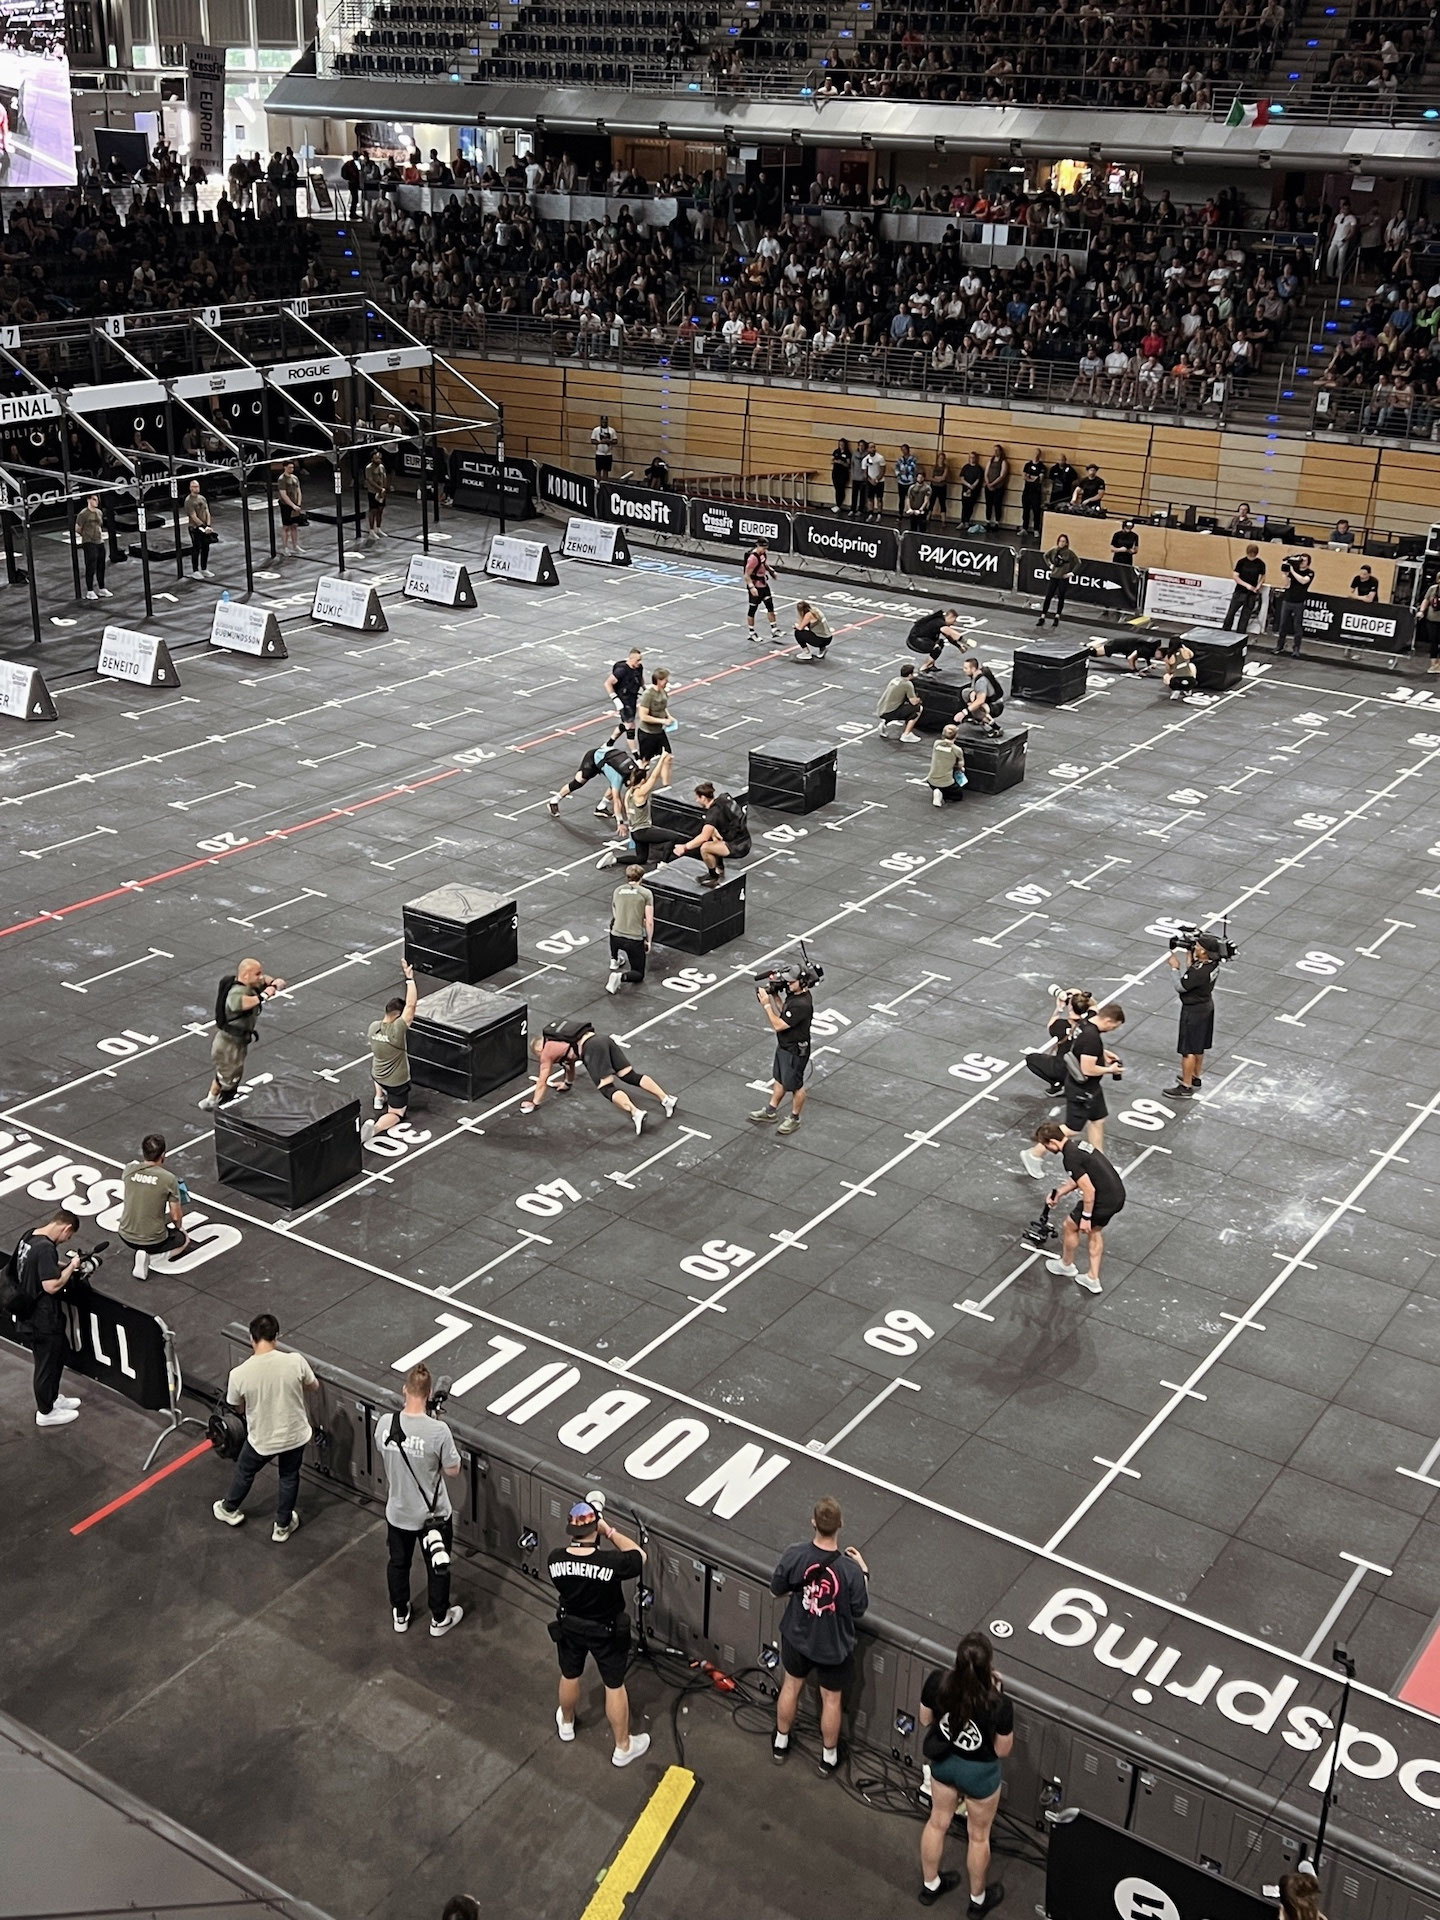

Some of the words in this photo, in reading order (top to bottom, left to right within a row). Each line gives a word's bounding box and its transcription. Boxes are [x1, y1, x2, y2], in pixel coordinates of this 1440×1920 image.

[200, 91, 212, 152] EUROPE
[296, 300, 308, 316] 10
[113, 318, 120, 334] 8
[210, 310, 216, 325] 9
[7, 329, 14, 345] 7
[288, 365, 330, 379] ROGUE
[2, 398, 53, 420] FINAL
[611, 493, 672, 525] CrossFit
[702, 513, 733, 529] CrossFit
[741, 522, 777, 536] EUROPE
[567, 541, 597, 555] ZENONI
[808, 527, 878, 558] foodspring
[615, 551, 625, 560] 10
[918, 544, 998, 573] PAVIGYM
[491, 559, 510, 573] EKAI
[543, 570, 550, 580] 9
[408, 580, 430, 594] FASA
[1034, 568, 1101, 588] GUCK
[459, 591, 466, 601] 8
[369, 615, 377, 625] 7
[1345, 616, 1392, 633] EUROPE
[268, 641, 275, 651] 6
[102, 656, 140, 675] BENEITO
[157, 668, 166, 680] 5
[33, 702, 42, 715] 4
[1292, 711, 1330, 726] 40
[836, 721, 873, 735] 10
[452, 746, 497, 764] 20
[1048, 762, 1090, 778] 30
[1167, 787, 1209, 805] 40
[1294, 811, 1339, 830] 50
[196, 831, 249, 853] 20
[763, 823, 809, 843] 20
[879, 851, 927, 871] 30
[1005, 882, 1053, 904] 40
[511, 915, 519, 930] 3
[536, 929, 590, 954] 20
[1296, 950, 1345, 975] 60
[662, 967, 717, 993] 30
[520, 1020, 527, 1035] 2
[97, 1028, 159, 1056] 10
[948, 1052, 1010, 1083] 50
[1117, 1098, 1177, 1131] 60
[363, 1122, 432, 1157] 30
[130, 1173, 159, 1186] JUDGE
[515, 1178, 583, 1217] 40
[679, 1239, 757, 1282] 50
[863, 1309, 937, 1357] 60
[391, 1312, 792, 1520] NOBULL
